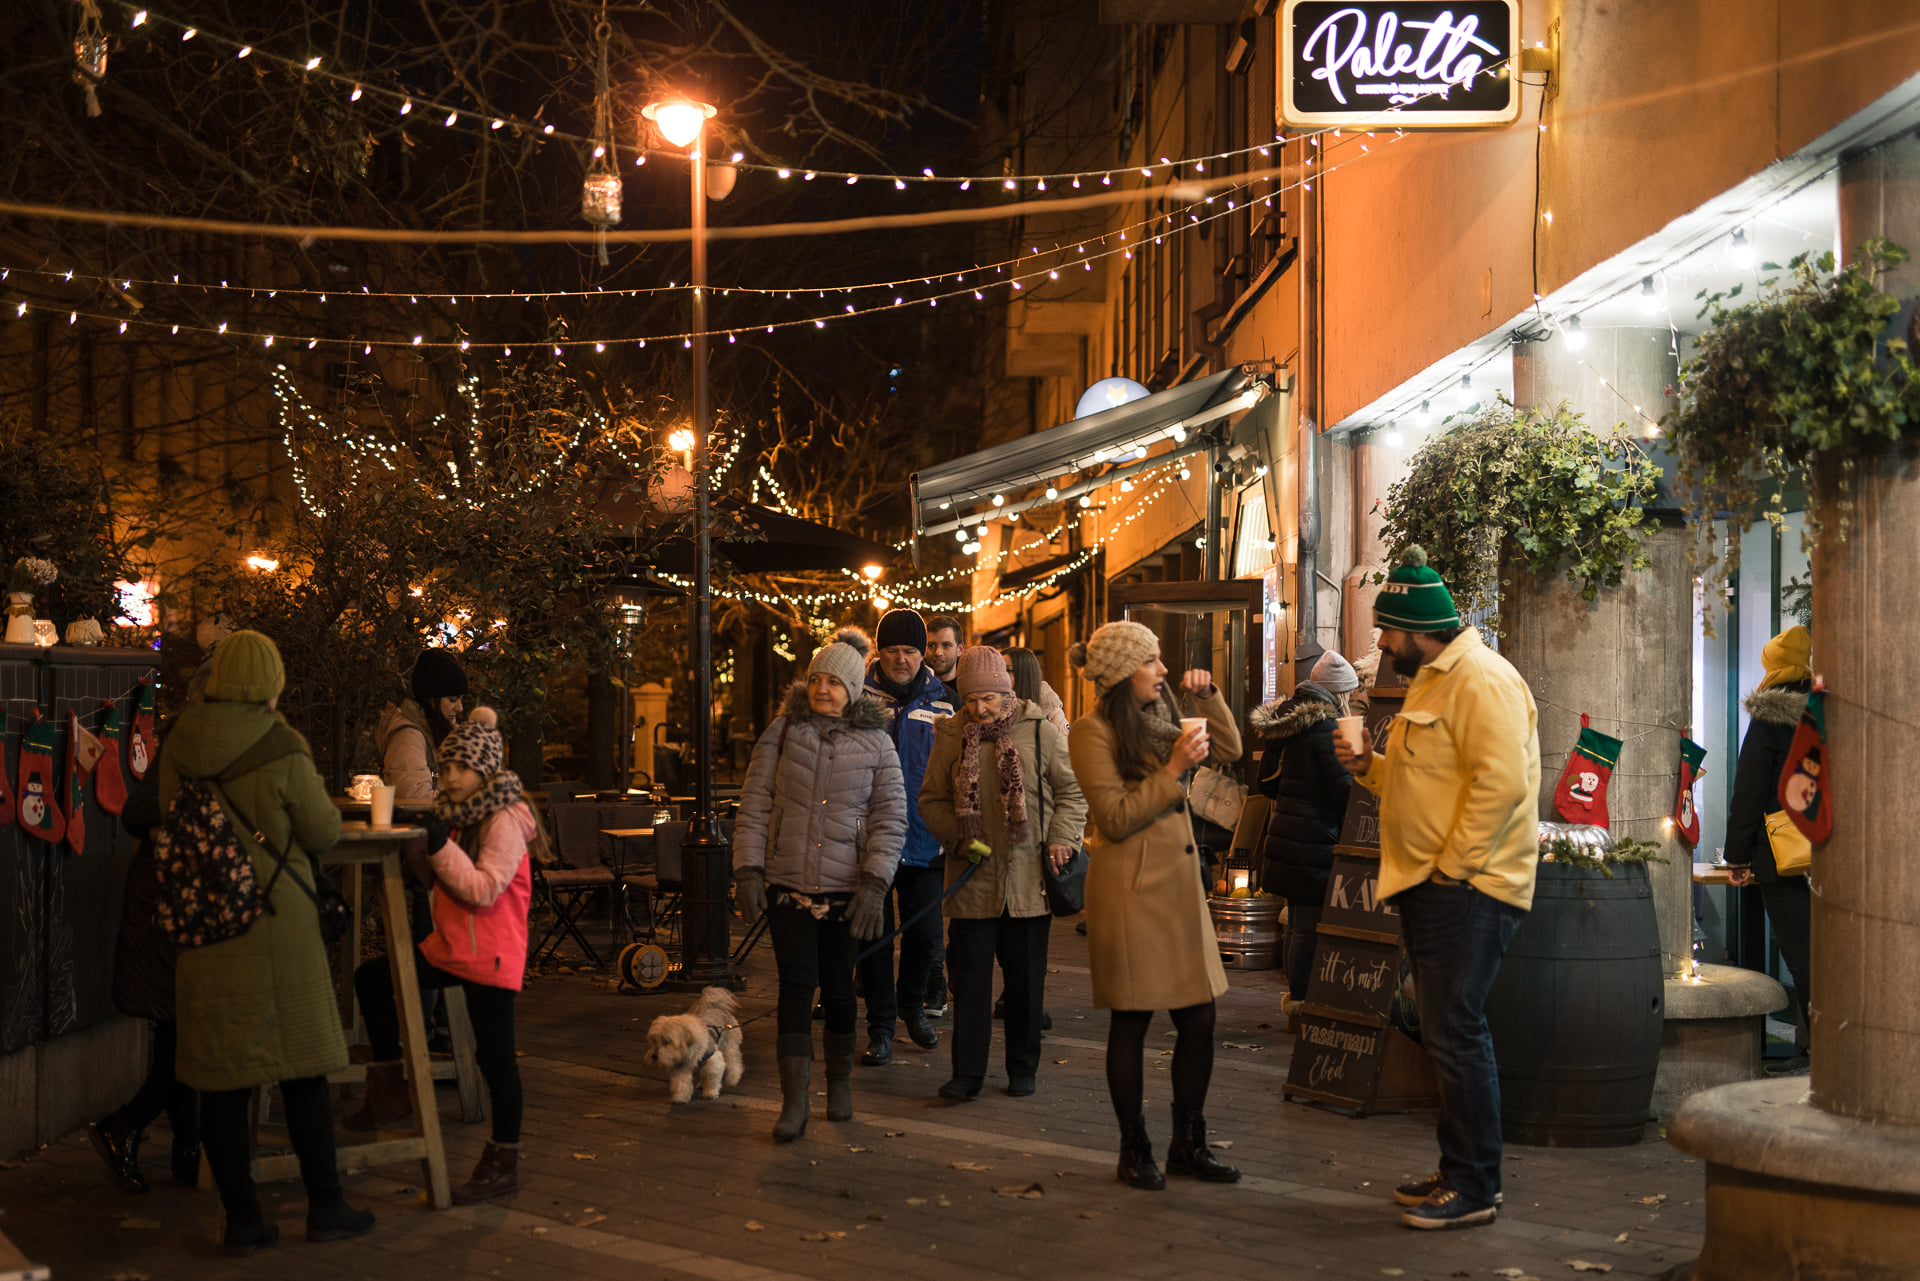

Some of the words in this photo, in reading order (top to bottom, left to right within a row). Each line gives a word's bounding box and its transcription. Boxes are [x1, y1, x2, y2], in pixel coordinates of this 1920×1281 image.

[1303, 8, 1501, 105] Paletta
[1319, 951, 1347, 984] itt
[1358, 960, 1393, 993] most
[1301, 1020, 1377, 1060] vasárnapi
[1308, 1052, 1346, 1087] Ebéd
